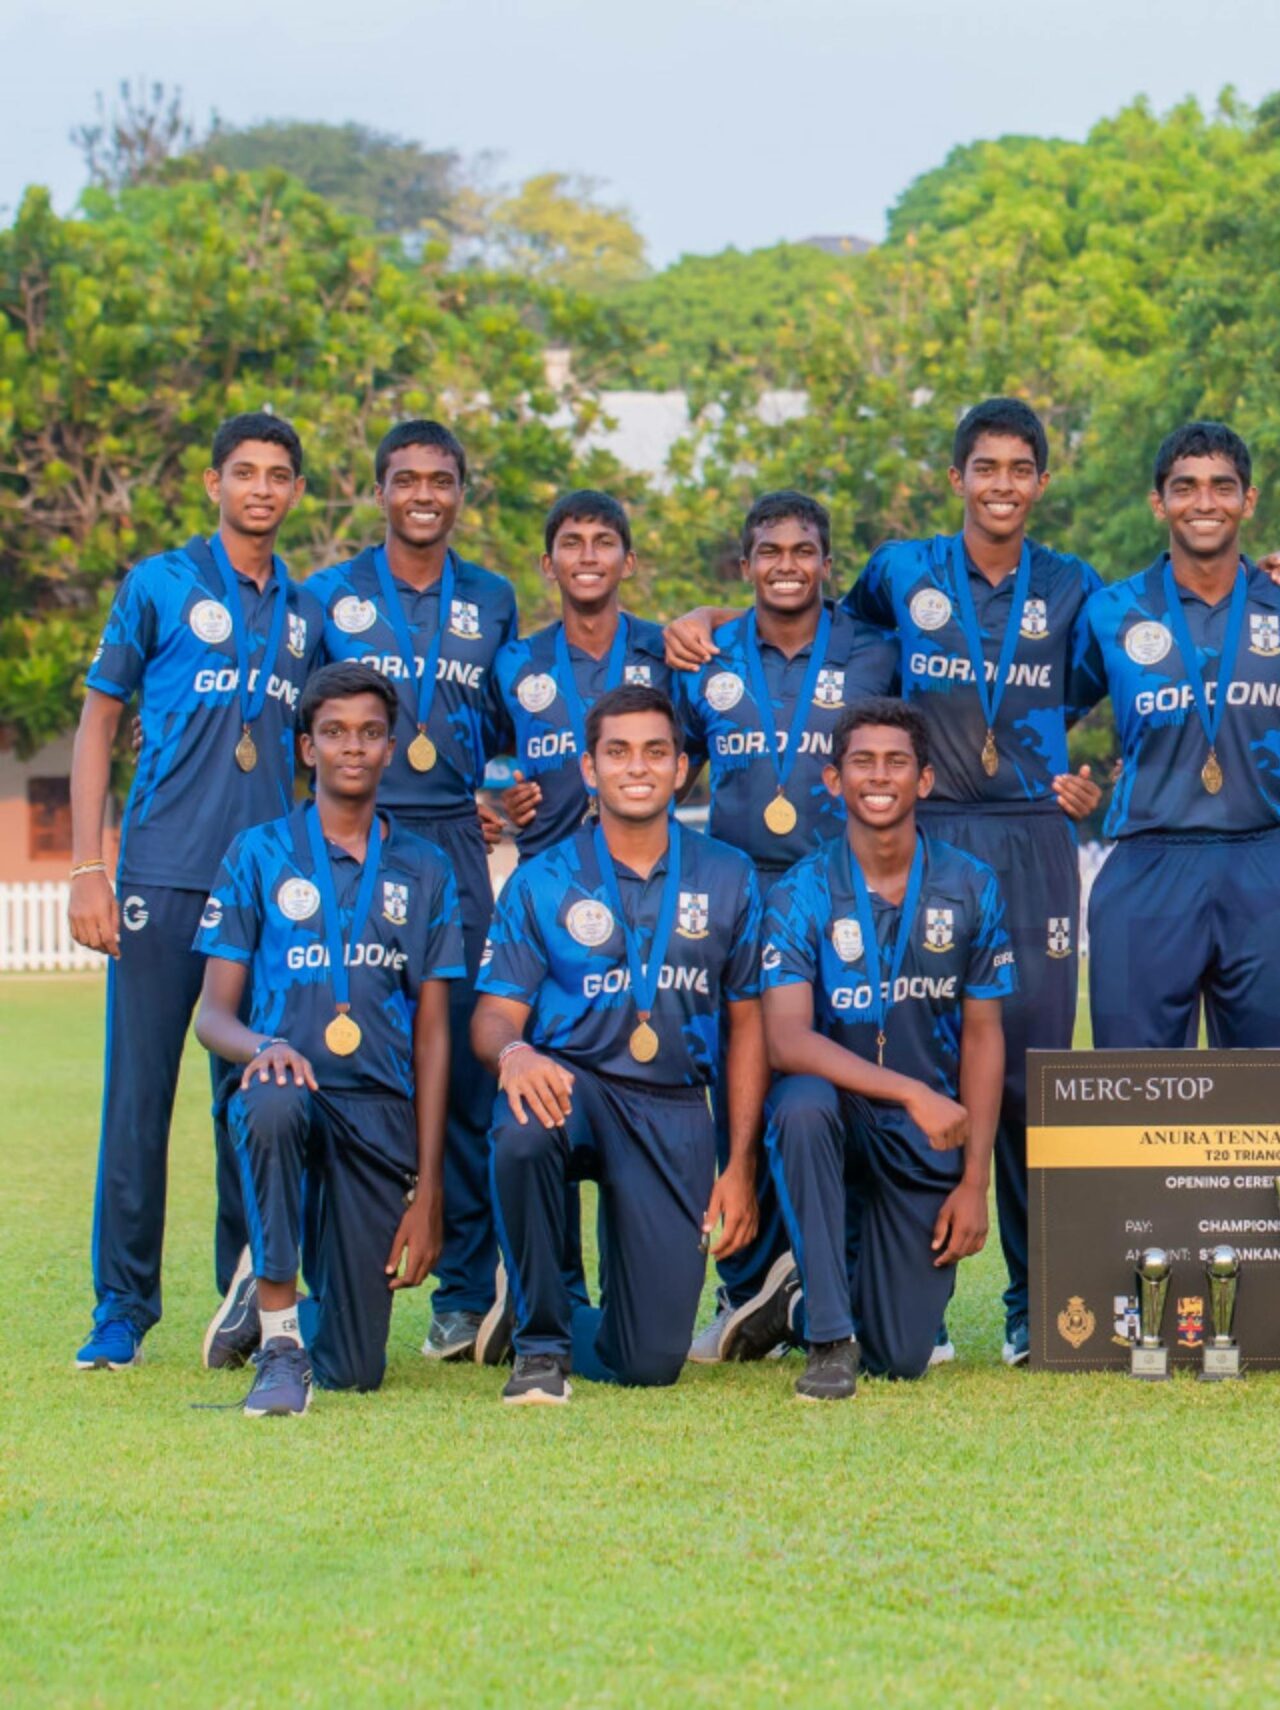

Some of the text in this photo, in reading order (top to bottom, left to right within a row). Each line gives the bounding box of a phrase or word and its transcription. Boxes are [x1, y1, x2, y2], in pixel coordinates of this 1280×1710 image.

[344, 655, 484, 689] ORDONE
[1055, 1077, 1214, 1101] MERC-STOP
[1139, 1130, 1210, 1145] ANURA
[1205, 1149, 1231, 1162] T20
[1165, 1175, 1231, 1189] OPENING
[1125, 1219, 1153, 1233] PAY:
